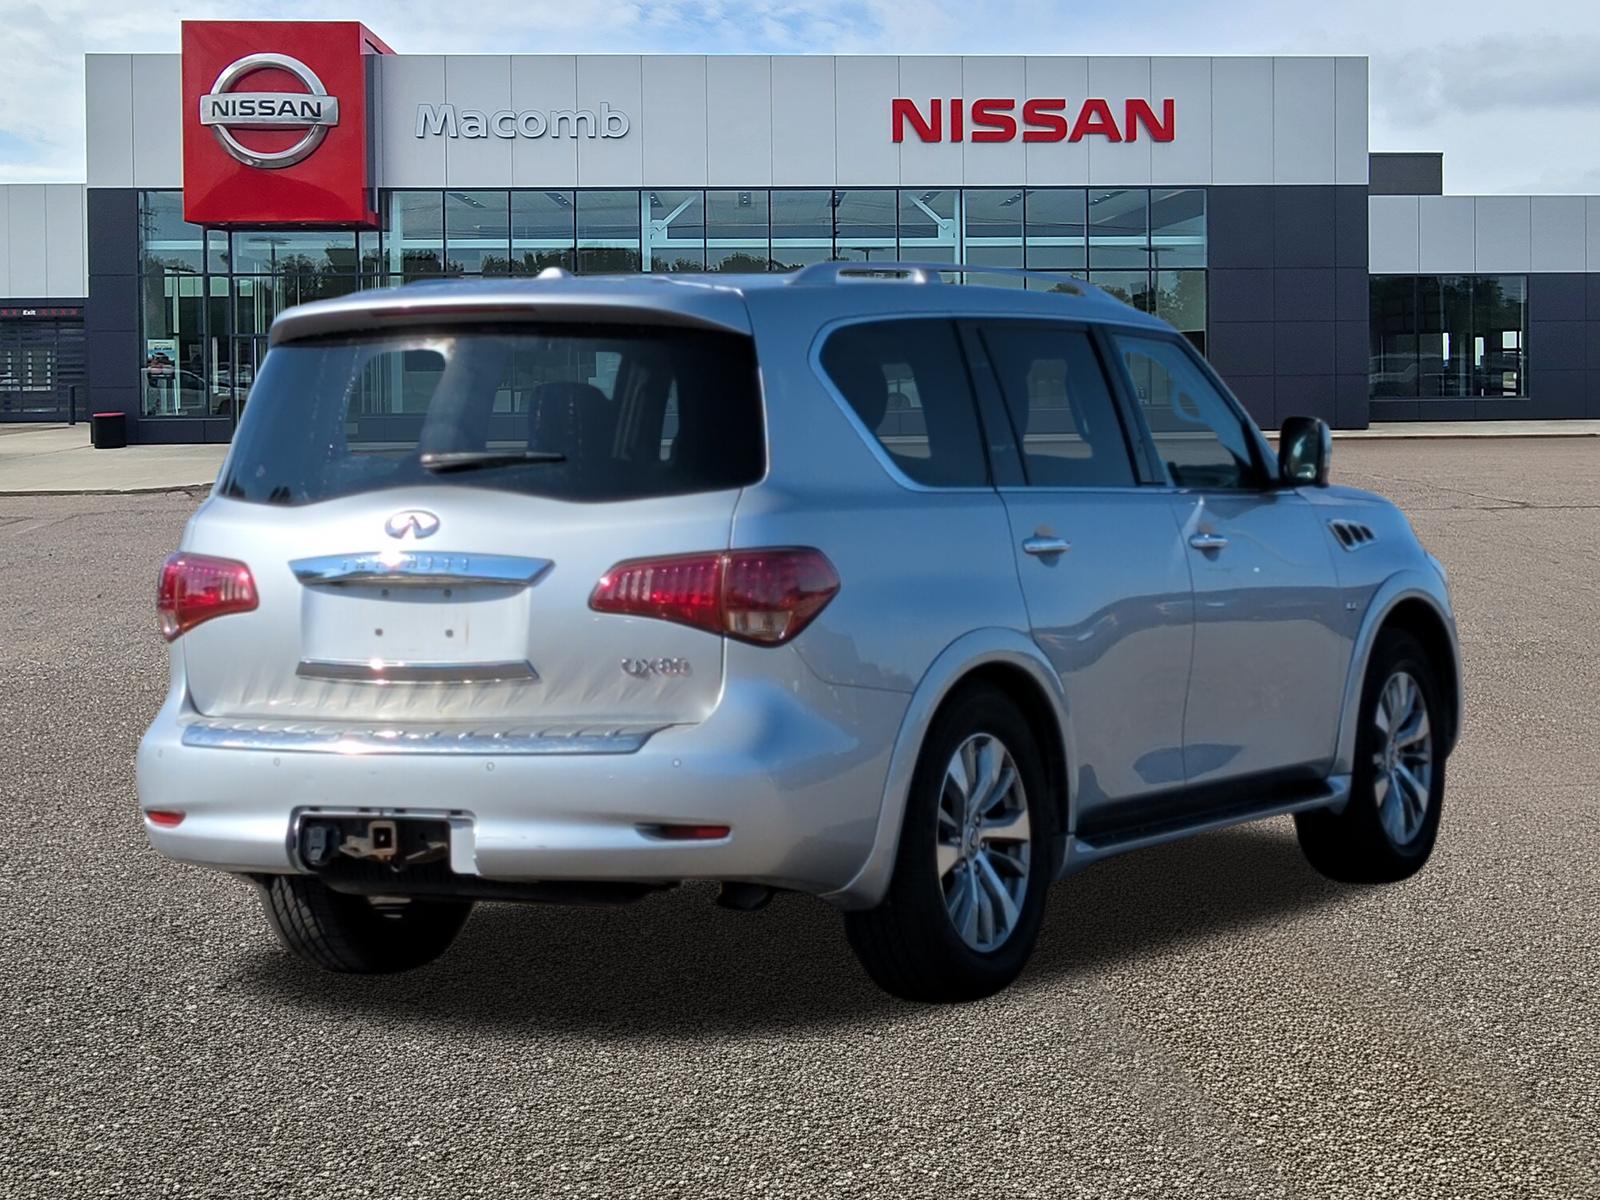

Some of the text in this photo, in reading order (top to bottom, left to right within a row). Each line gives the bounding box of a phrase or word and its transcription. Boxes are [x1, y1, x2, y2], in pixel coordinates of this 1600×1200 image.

[211, 100, 321, 117] NISSAN
[415, 102, 630, 138] Macomb
[892, 98, 1175, 143] NISSAN
